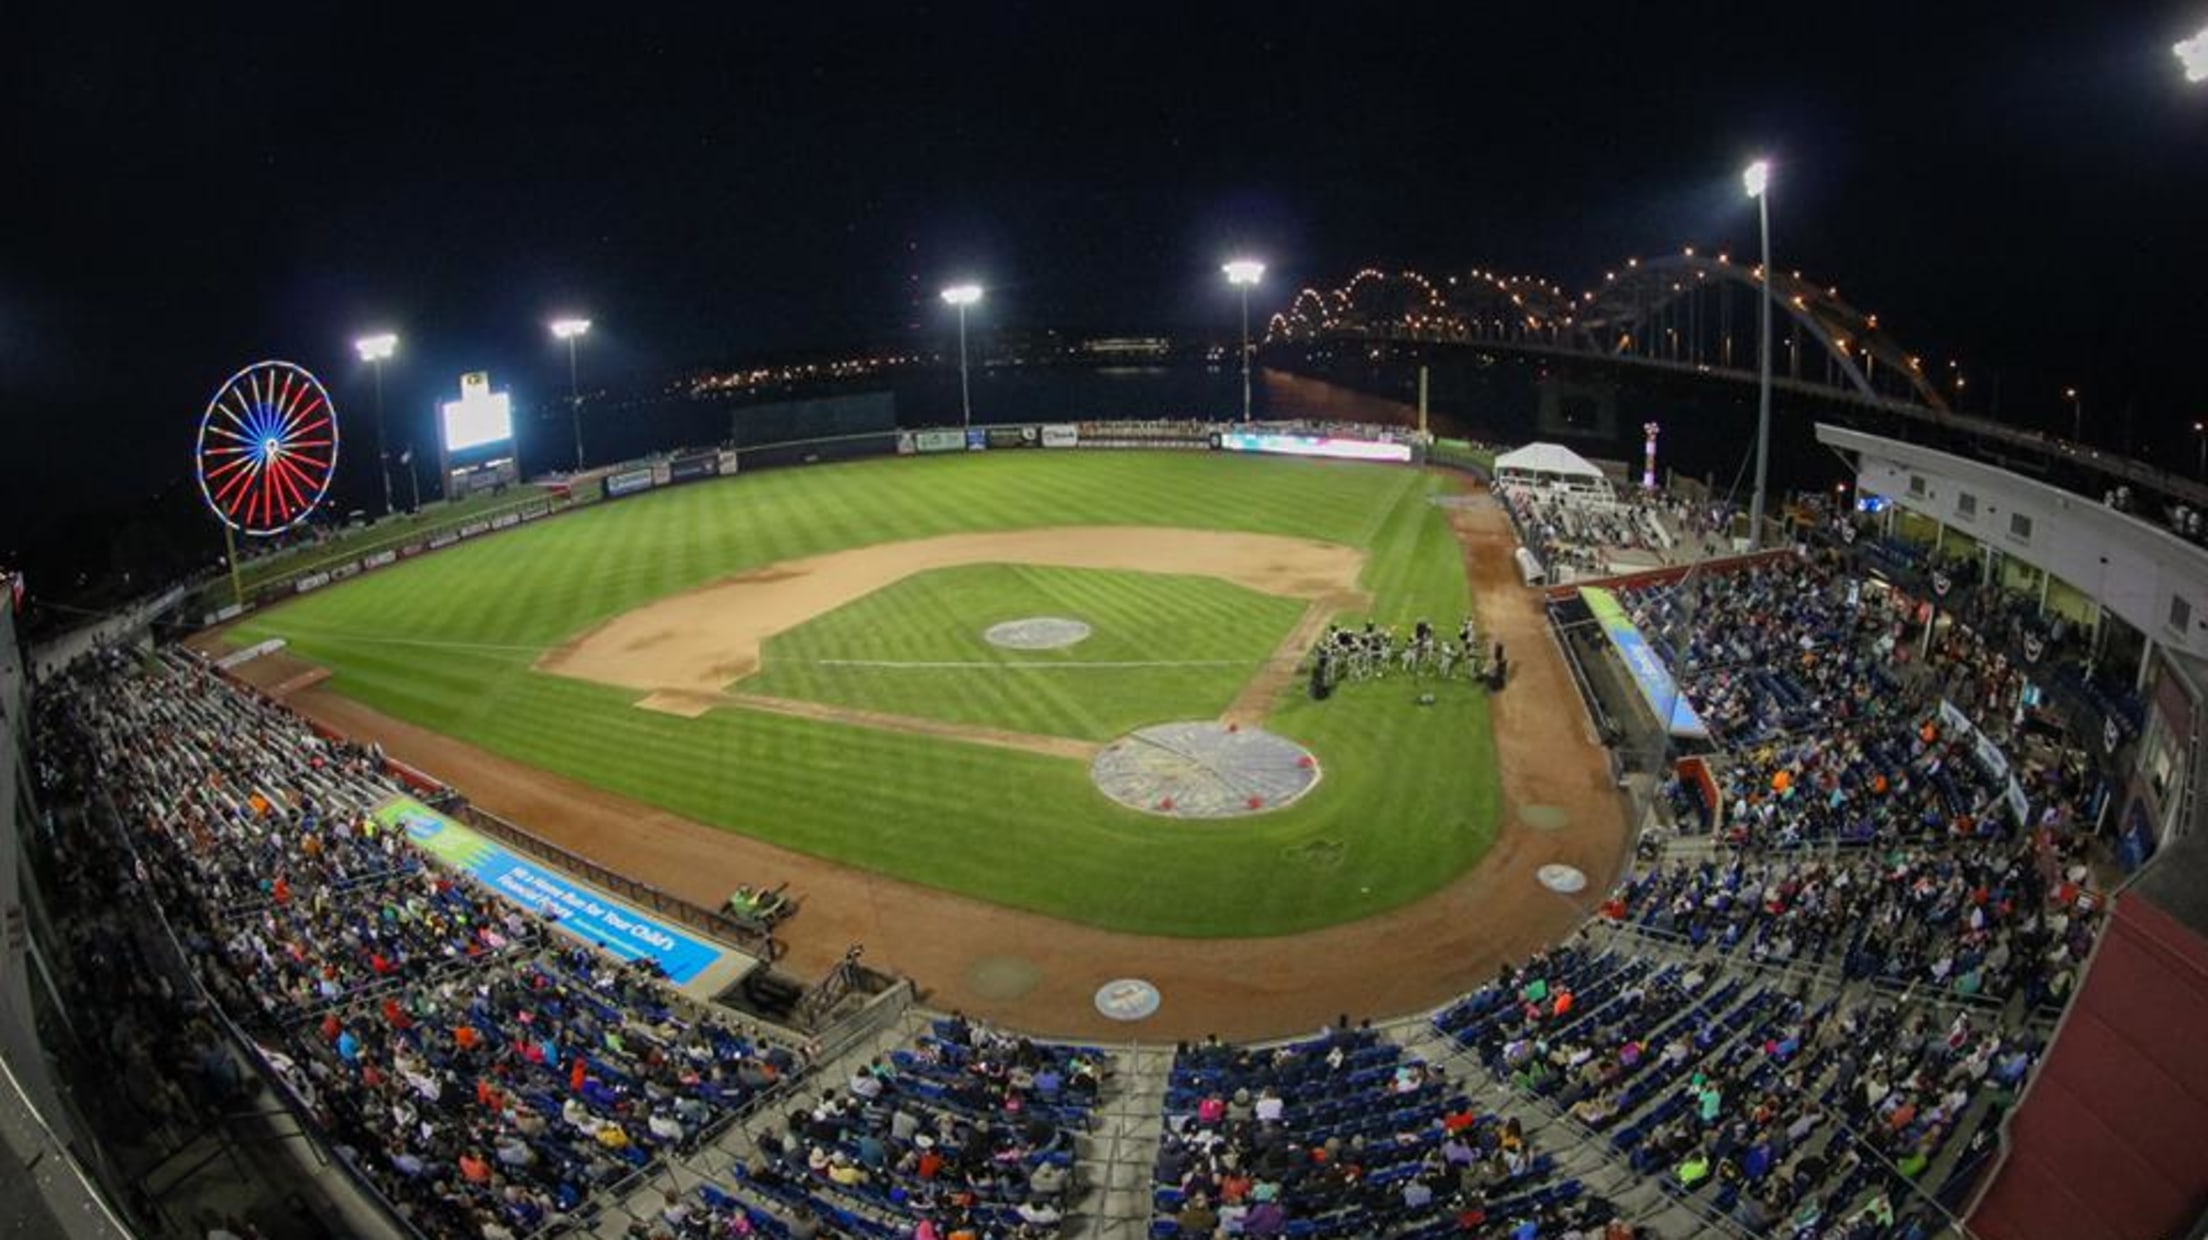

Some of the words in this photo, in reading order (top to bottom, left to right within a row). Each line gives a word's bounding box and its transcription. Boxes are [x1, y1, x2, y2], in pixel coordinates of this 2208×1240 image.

[533, 878, 564, 897] Home
[562, 892, 588, 908] Run
[585, 902, 604, 917] for
[603, 911, 633, 931] Your
[630, 924, 675, 951] Child's
